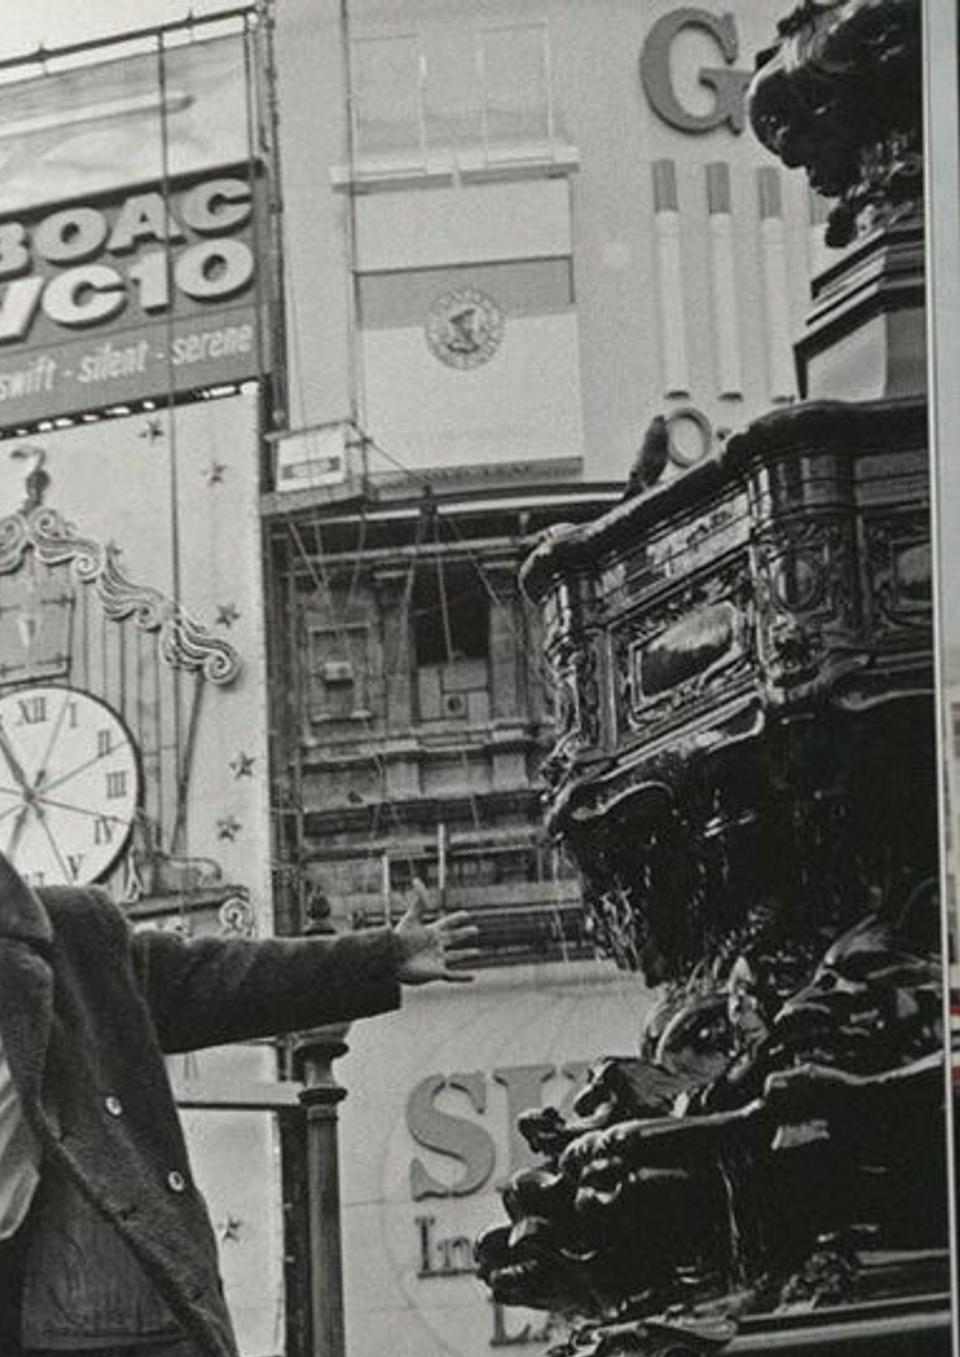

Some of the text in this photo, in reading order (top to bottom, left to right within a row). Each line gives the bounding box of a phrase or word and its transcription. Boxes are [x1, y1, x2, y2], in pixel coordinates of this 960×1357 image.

[77, 340, 149, 383] silent
[172, 325, 254, 366] serene
[105, 770, 127, 800] III
